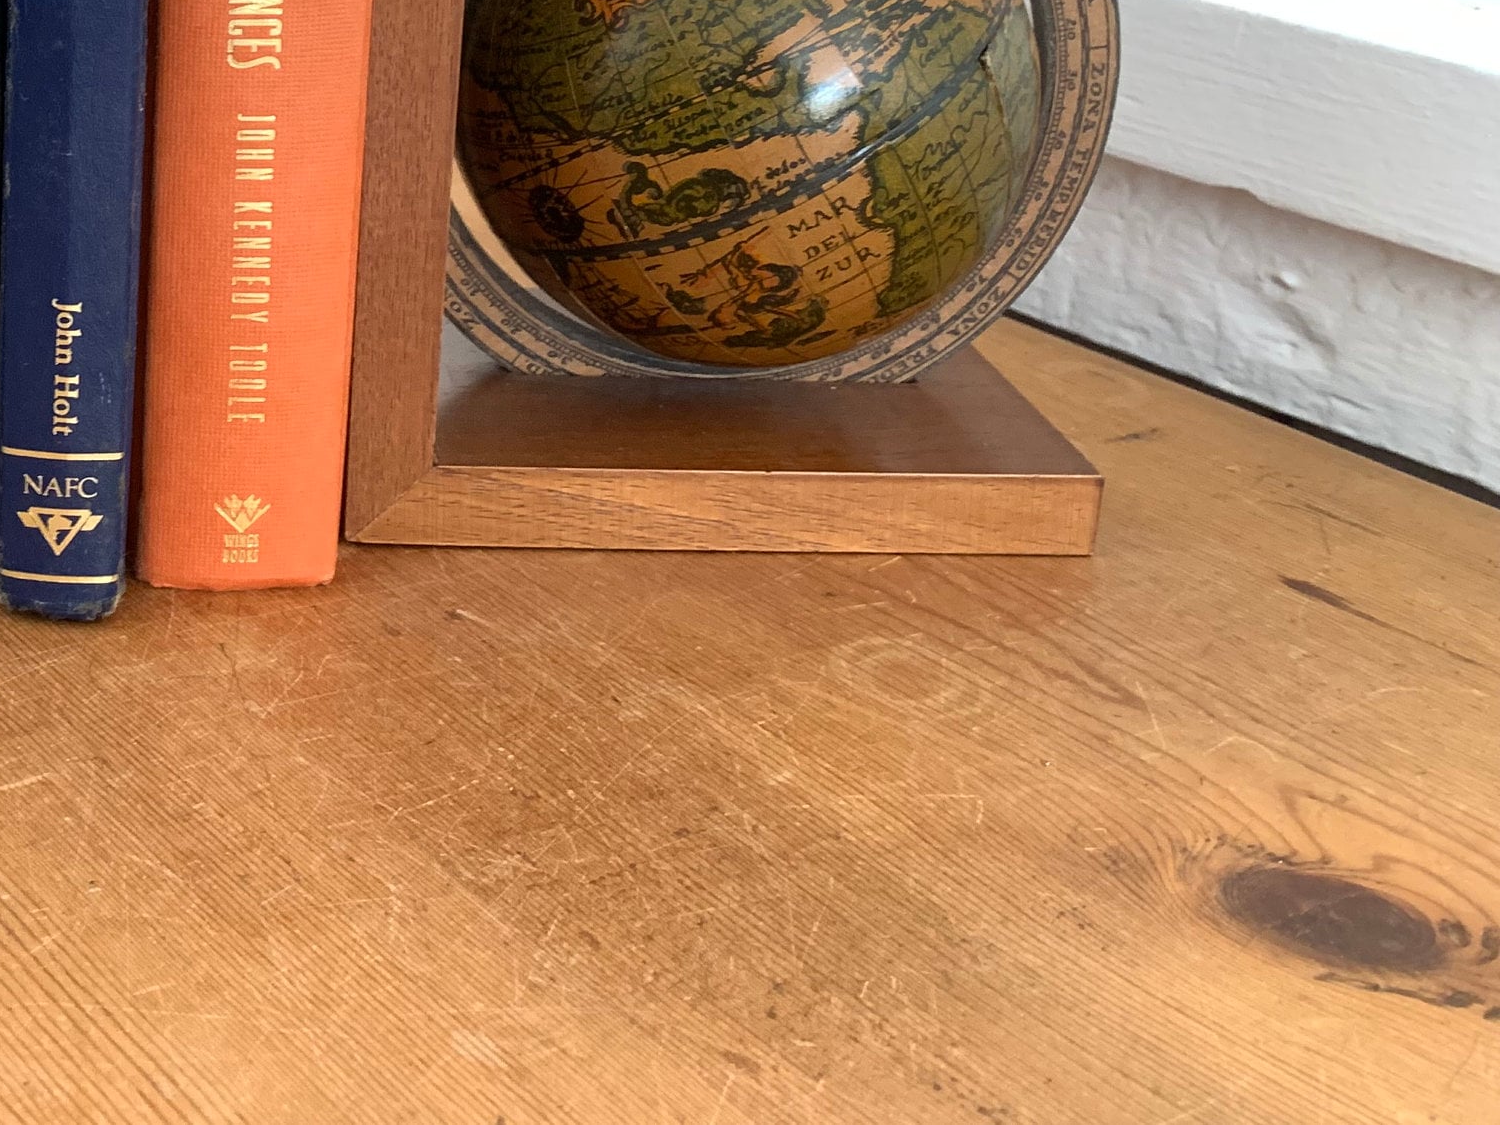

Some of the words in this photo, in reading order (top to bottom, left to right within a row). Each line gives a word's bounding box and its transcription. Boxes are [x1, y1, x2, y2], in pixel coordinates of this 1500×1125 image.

[1081, 62, 1106, 134] ZONA
[235, 113, 276, 181] JOHN
[786, 196, 860, 240] MAR
[230, 201, 273, 323] KENNEDY
[816, 246, 882, 282] ZUR
[51, 298, 83, 365] John
[946, 284, 1008, 337] ZONA
[51, 374, 80, 436] Holt
[227, 342, 268, 423] TOOLE
[23, 474, 98, 498] NAFC
